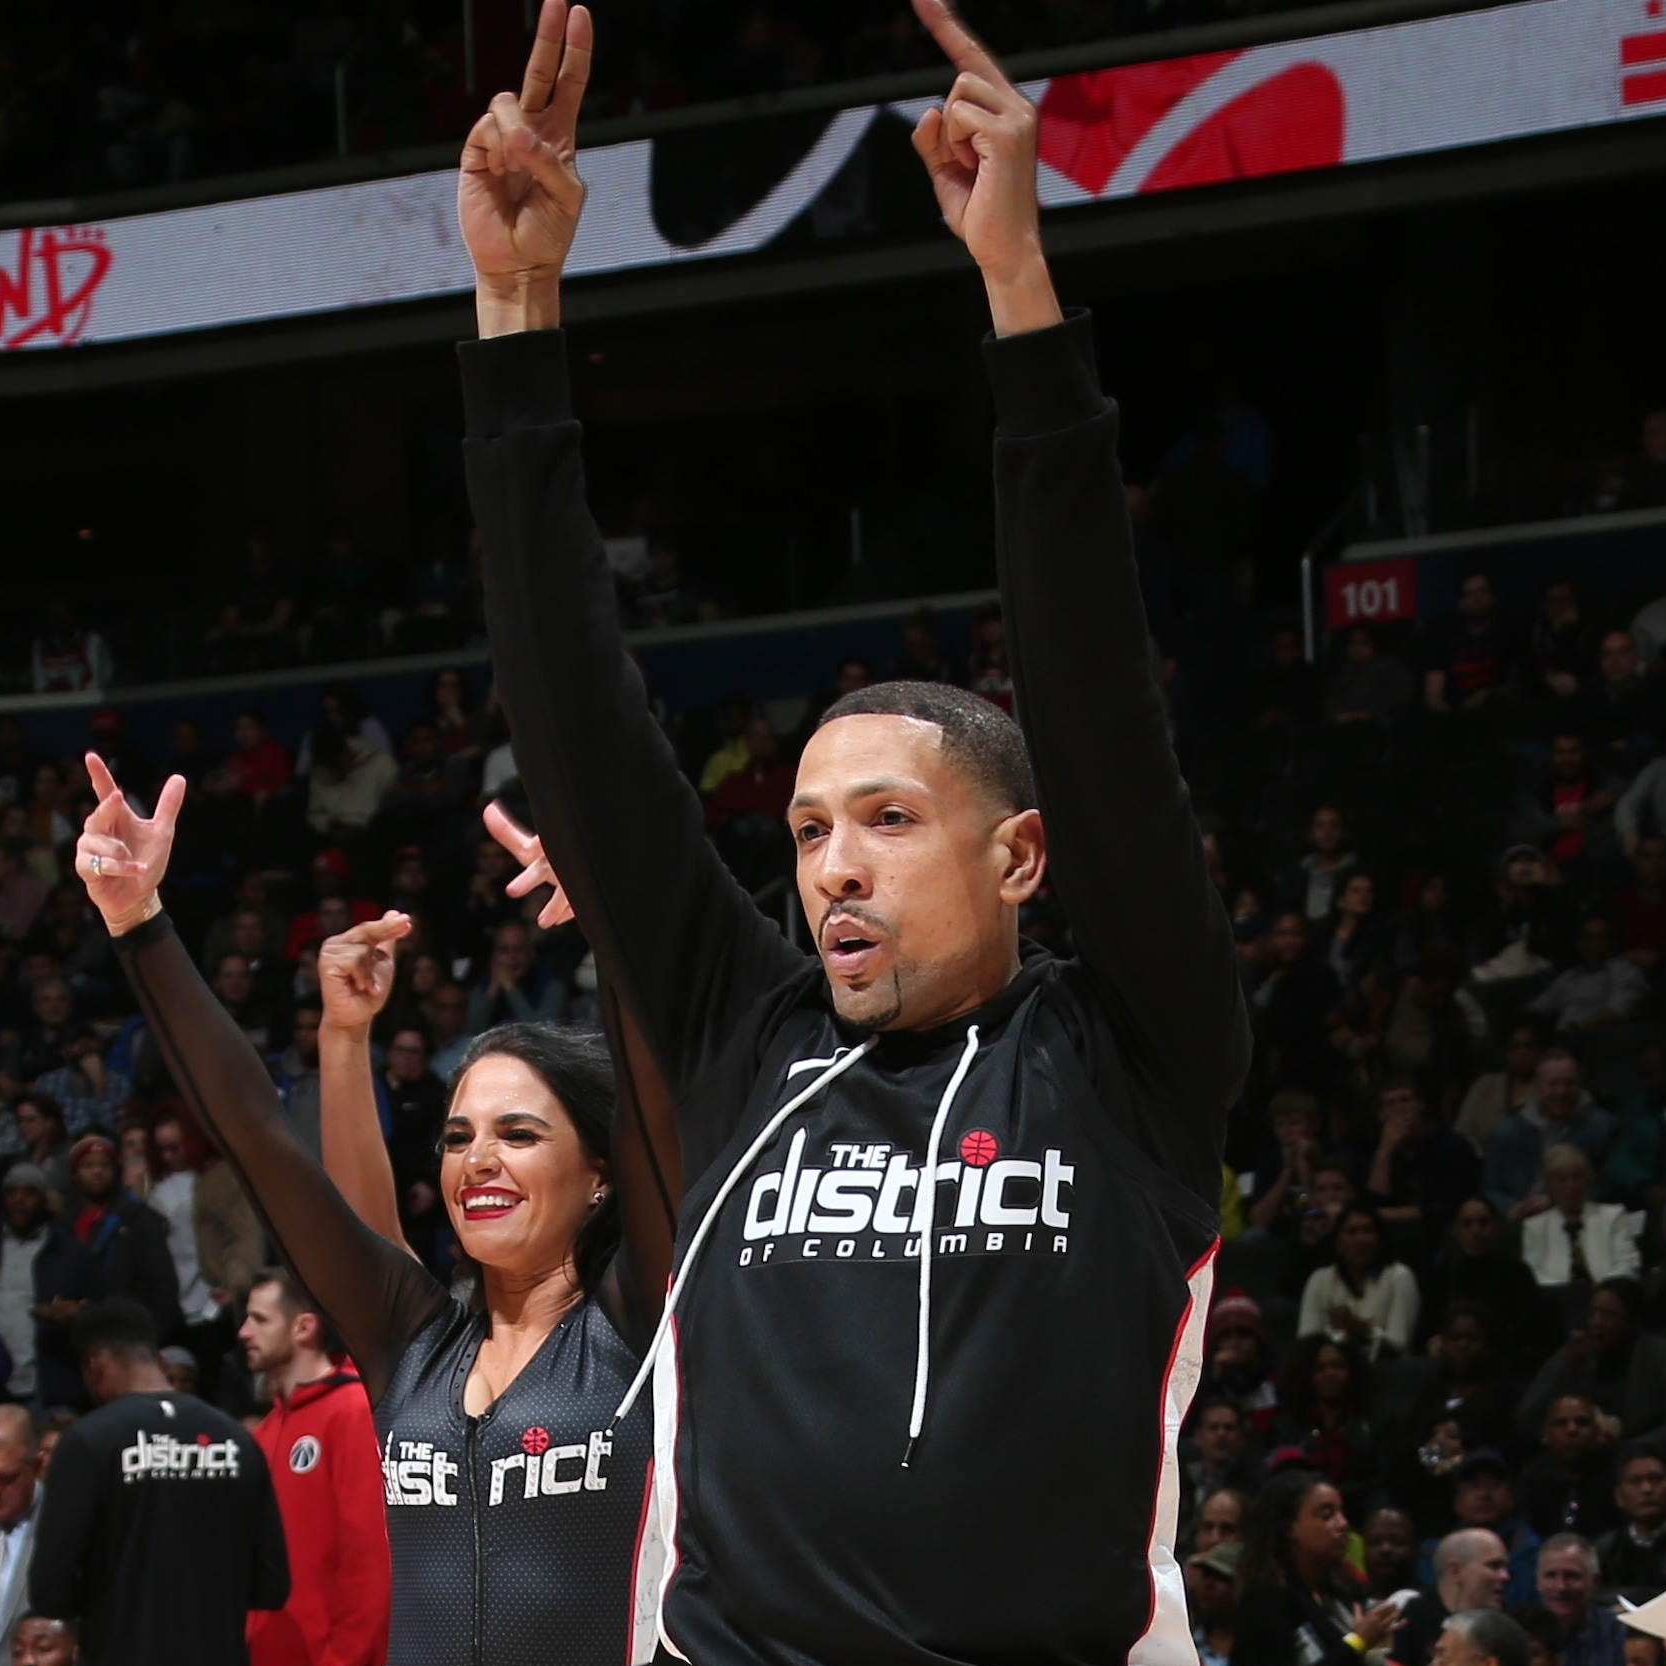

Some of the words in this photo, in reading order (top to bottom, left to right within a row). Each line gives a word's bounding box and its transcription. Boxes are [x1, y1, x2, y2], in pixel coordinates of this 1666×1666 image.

[1340, 576, 1400, 618] 101
[830, 1144, 891, 1169] THE
[742, 1126, 1075, 1242] district
[738, 1242, 776, 1267] OF
[398, 1441, 435, 1461] THE
